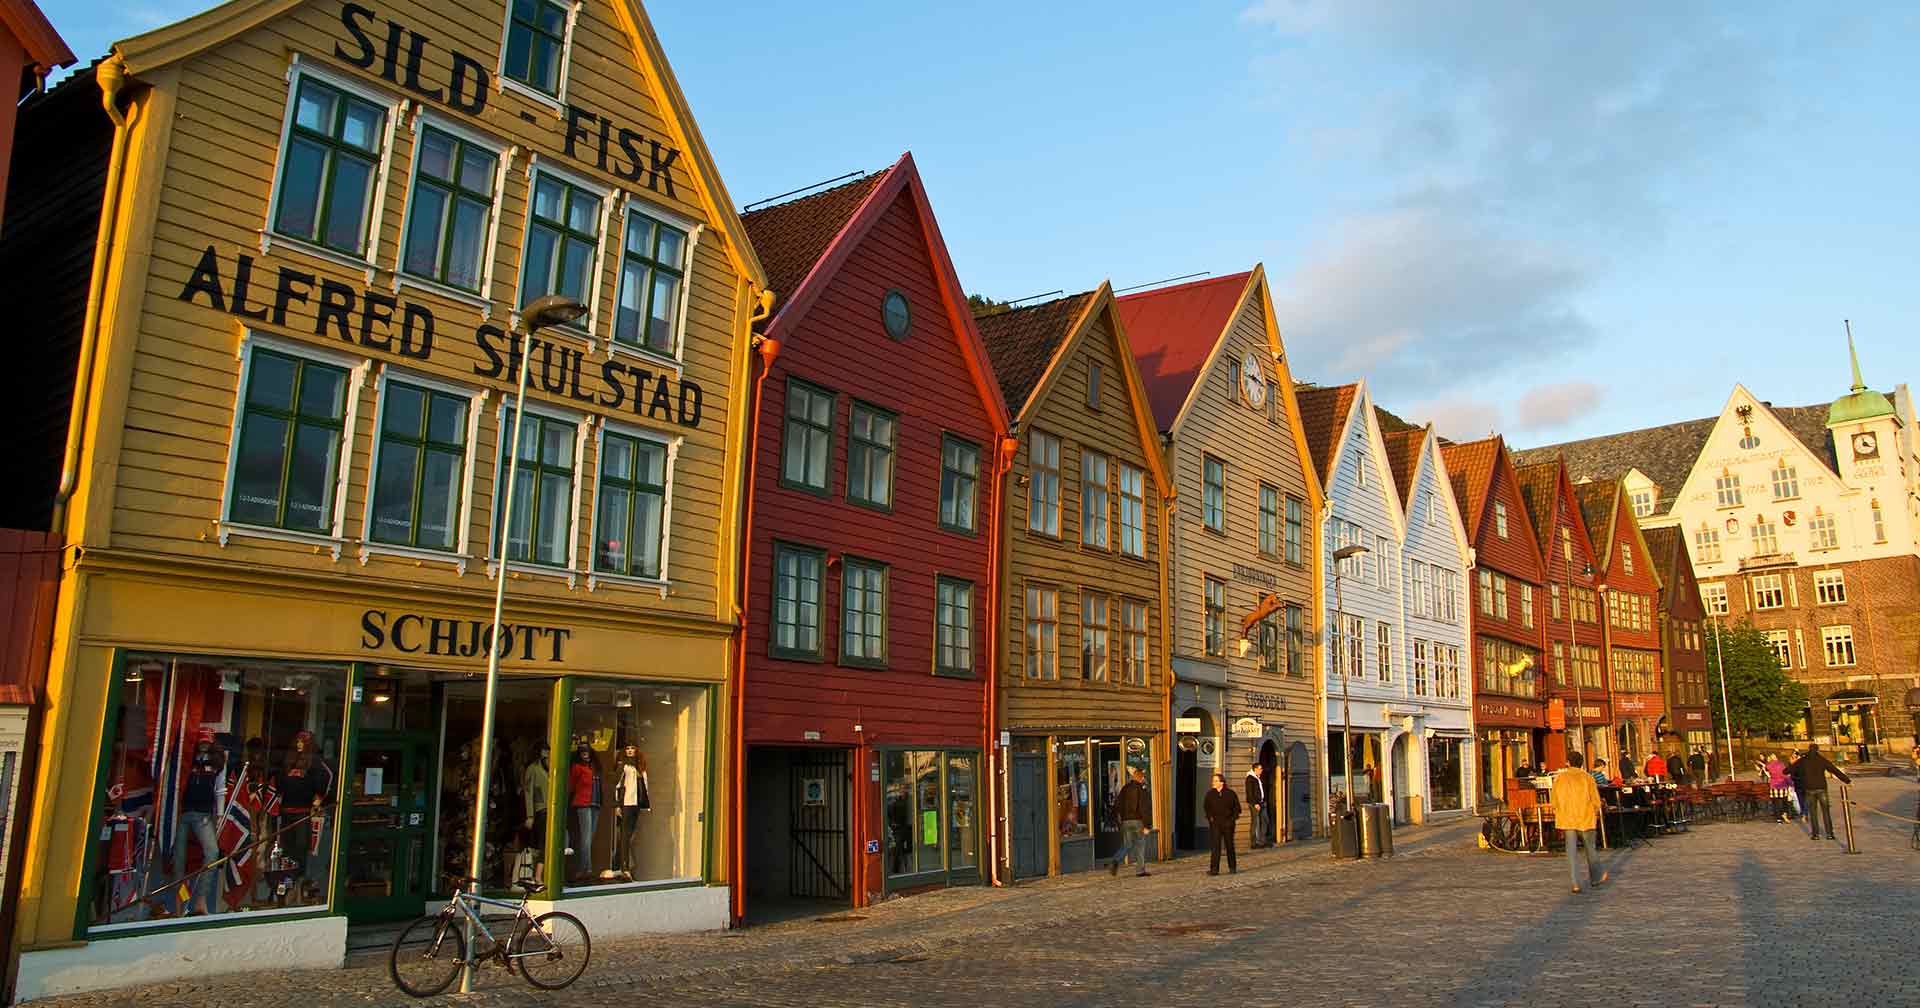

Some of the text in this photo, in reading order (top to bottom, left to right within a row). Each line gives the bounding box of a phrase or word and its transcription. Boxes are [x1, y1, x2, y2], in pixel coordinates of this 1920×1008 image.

[334, 2, 489, 117] SILD
[563, 107, 681, 198] FISK
[179, 245, 703, 427] ALFRED SKULSTAD
[361, 610, 571, 662] SCHJØTT
